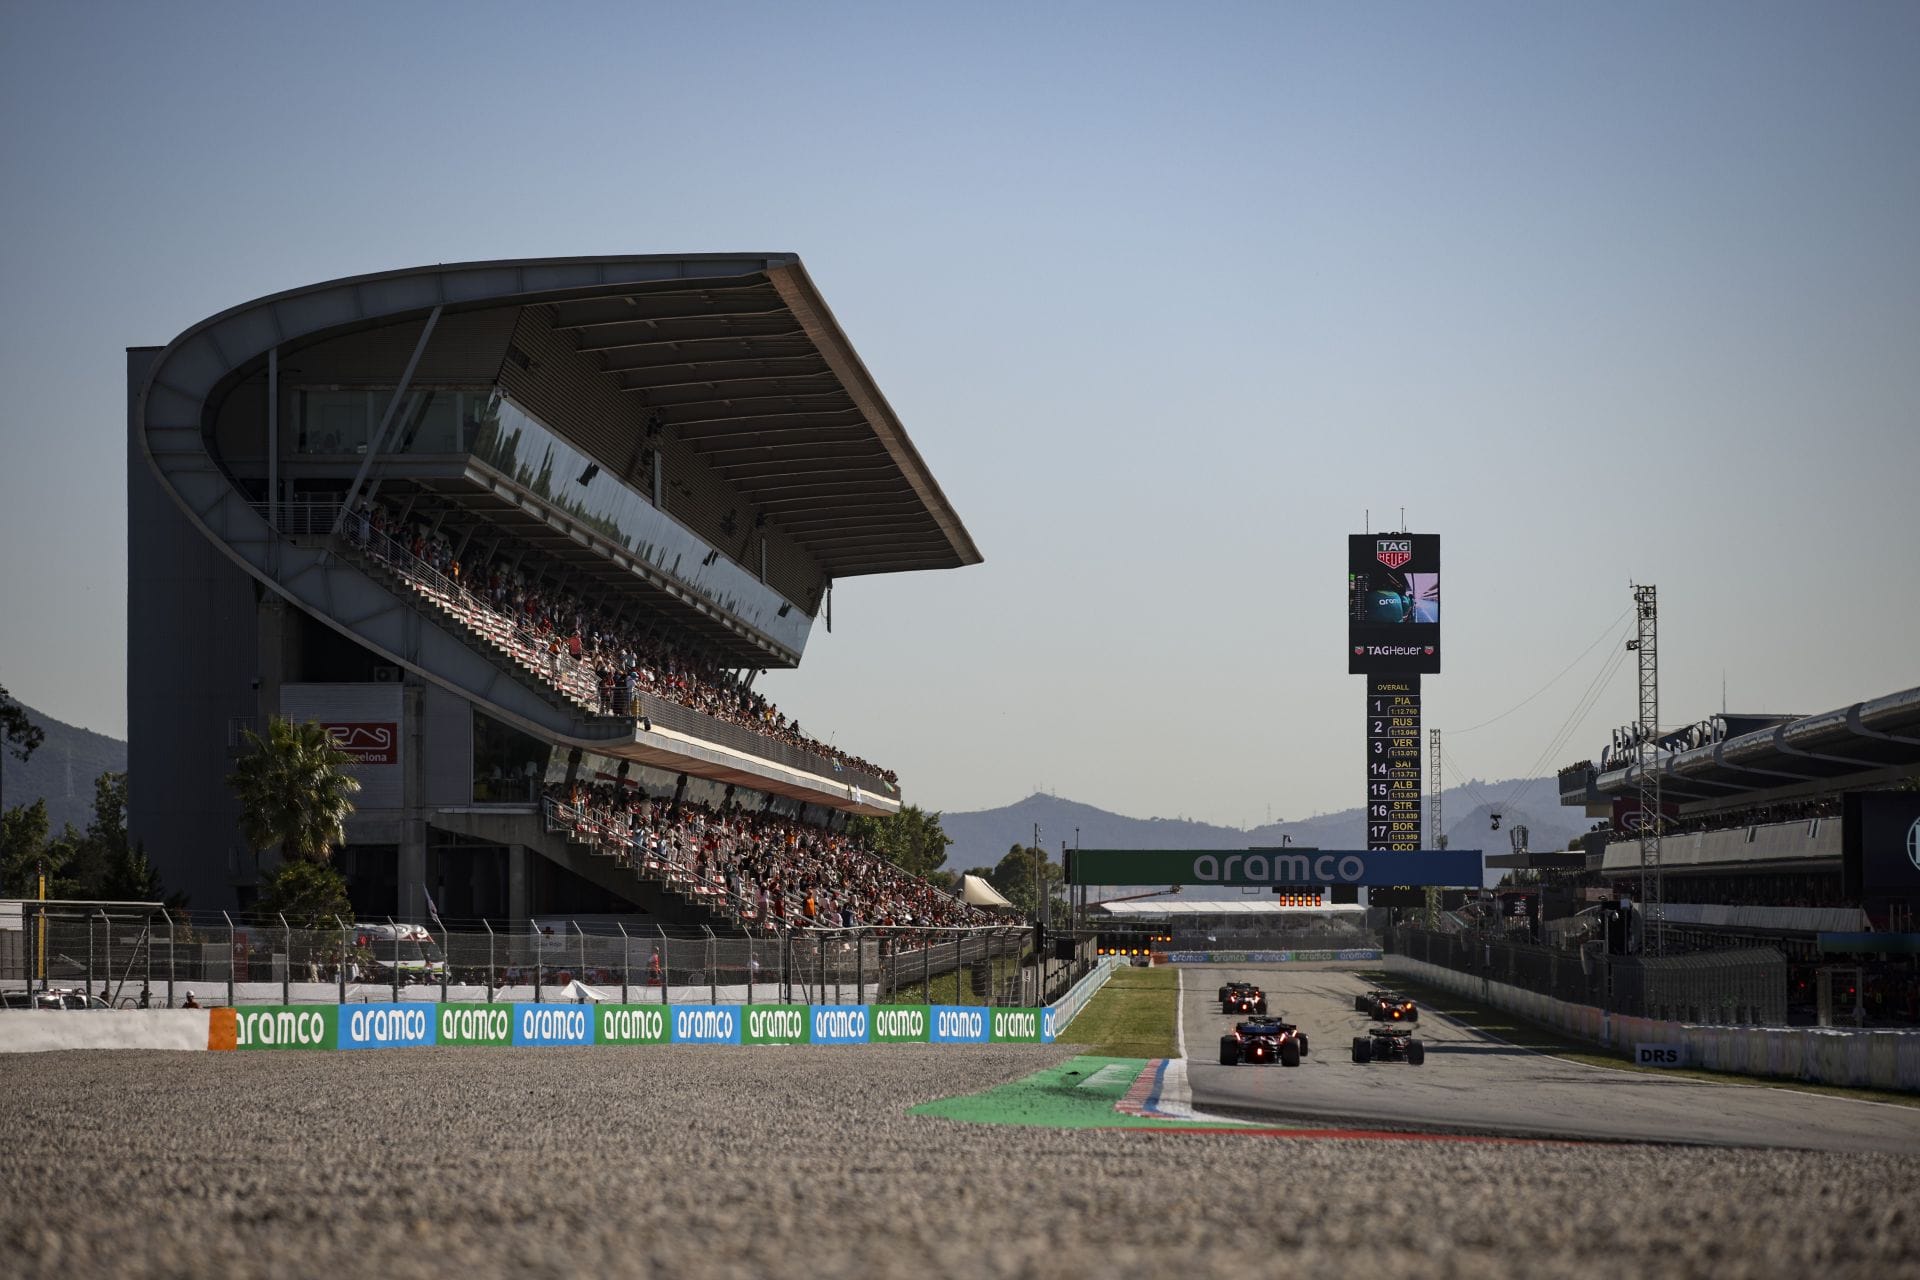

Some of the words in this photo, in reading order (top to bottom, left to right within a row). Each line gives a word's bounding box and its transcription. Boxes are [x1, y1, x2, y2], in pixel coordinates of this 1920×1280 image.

[1380, 542, 1408, 551] TAG
[1379, 552, 1409, 567] HEUER
[1375, 700, 1381, 712] 1
[1394, 697, 1411, 705] PIA
[1374, 721, 1382, 733] 2
[1392, 718, 1413, 726] RUS
[1374, 741, 1383, 754] 3
[1393, 738, 1413, 747] VER
[1371, 763, 1387, 775] 14
[1395, 760, 1411, 768] SAI
[1371, 783, 1387, 796] 15
[1393, 780, 1413, 789] ALB
[1371, 804, 1387, 817] 16
[1393, 801, 1413, 810] STR
[1371, 825, 1387, 838] 17
[1392, 822, 1414, 831] BOR
[1392, 843, 1414, 851] OCO
[1193, 854, 1364, 882] aramco
[351, 1010, 425, 1041] aramco
[442, 1010, 508, 1040] aramco
[523, 1009, 586, 1040] aramco
[603, 1010, 663, 1040] aramco
[677, 1010, 733, 1039] aramco
[749, 1010, 802, 1038] aramco
[816, 1010, 866, 1038] aramco
[876, 1010, 924, 1037] aramco
[938, 1011, 982, 1038] aramco
[995, 1012, 1036, 1038] aramco
[1640, 1049, 1678, 1063] DRS
